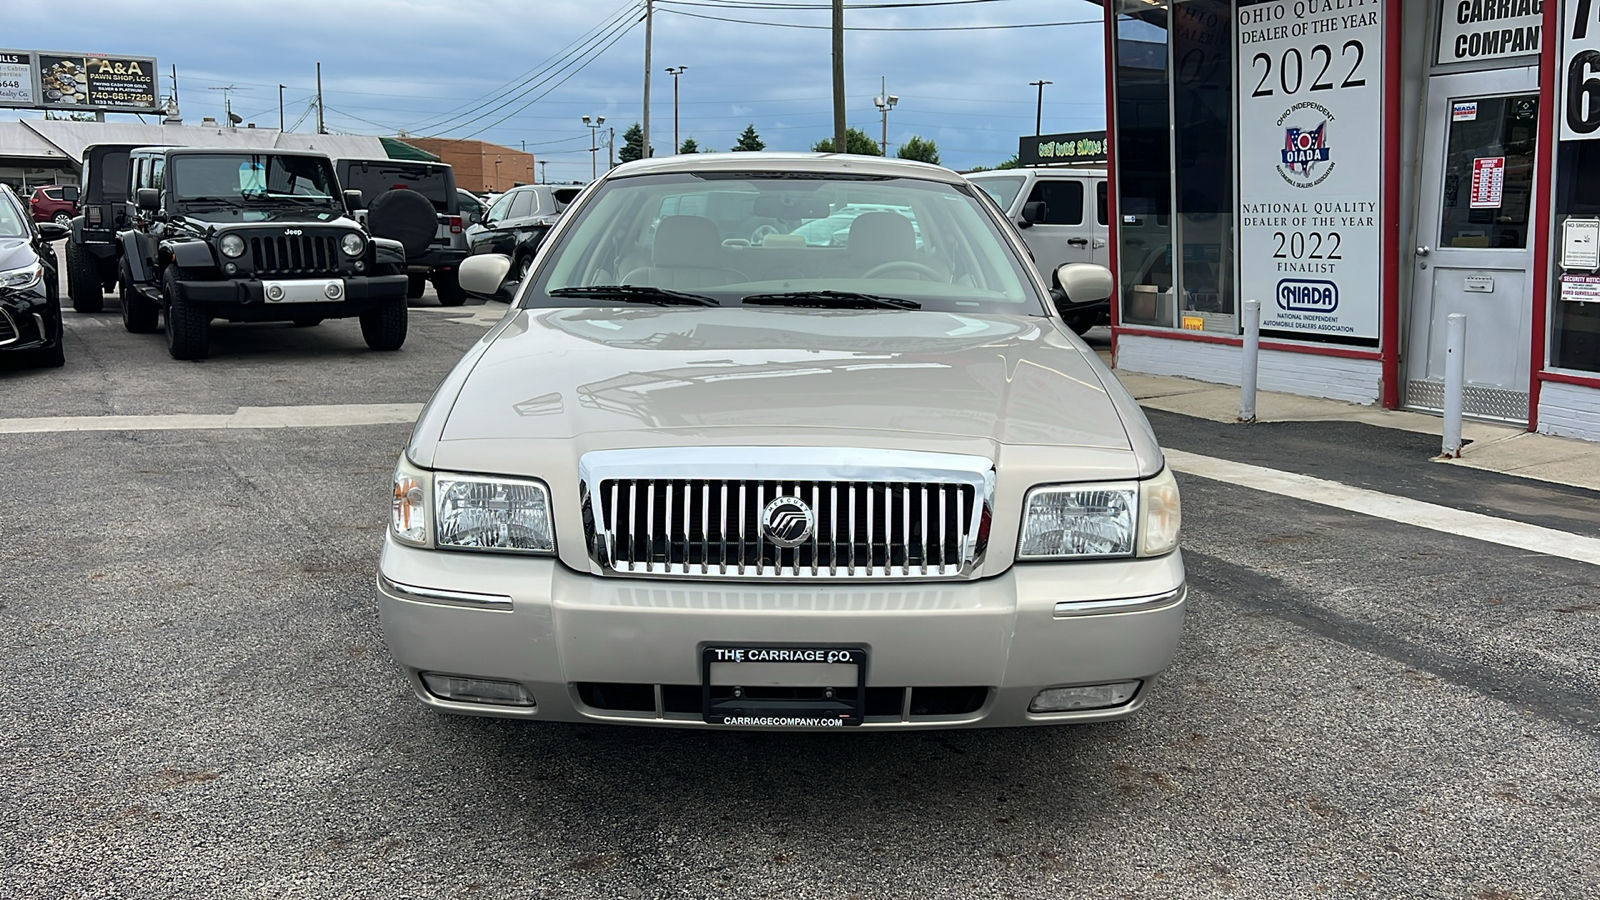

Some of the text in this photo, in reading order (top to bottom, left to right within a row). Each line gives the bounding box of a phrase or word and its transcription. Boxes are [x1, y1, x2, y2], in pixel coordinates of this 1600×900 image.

[1240, 0, 1378, 25] OHIO QUALI
[1457, 0, 1543, 24] CARRIAG
[1242, 11, 1377, 44] DEALER OF THE YEAR
[1455, 26, 1542, 58] COMPAN
[99, 60, 143, 75] A&A
[1252, 39, 1366, 97] 2022
[91, 91, 153, 101] 740-681-7296
[1276, 101, 1335, 127] OHIO INDEPENDENT
[1286, 149, 1321, 162] OIADA
[1243, 202, 1376, 214] NATIONAL QUALITY
[1244, 217, 1374, 226] DEALER OF THE YEAR
[284, 228, 303, 236] Jeep
[1272, 231, 1342, 259] 2022
[1277, 262, 1336, 273] FINALIST
[1281, 285, 1333, 306] NIADA
[1303, 314, 1338, 322] INDEPENDENT
[1318, 324, 1354, 332] ASSOCIATION
[768, 497, 808, 512] MERCURY
[715, 649, 853, 662] THE CARRIAGE CO.
[724, 717, 843, 727] CARRIAGECOMPANY.COM
